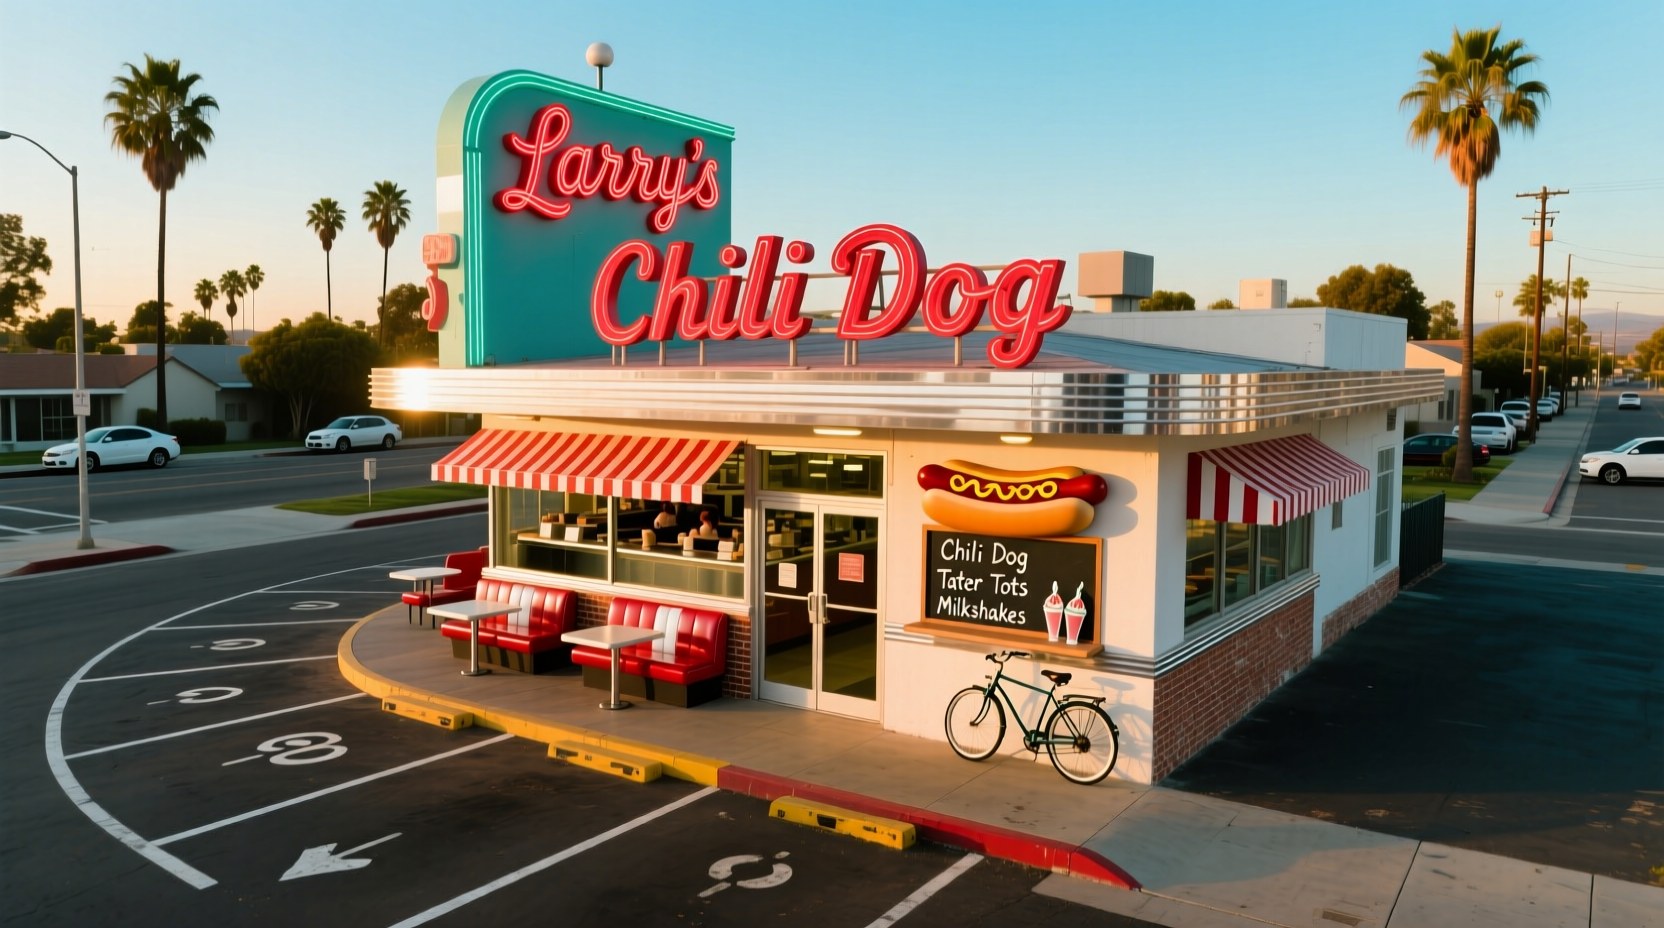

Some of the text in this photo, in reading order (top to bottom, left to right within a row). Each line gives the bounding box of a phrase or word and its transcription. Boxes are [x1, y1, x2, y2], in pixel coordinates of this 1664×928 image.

[493, 104, 720, 234] Larry's
[591, 223, 1073, 369] Chili Dog
[940, 538, 1028, 574] Chili Dog
[936, 568, 1028, 597] Tater Tots
[936, 595, 1026, 625] Milkshakes
